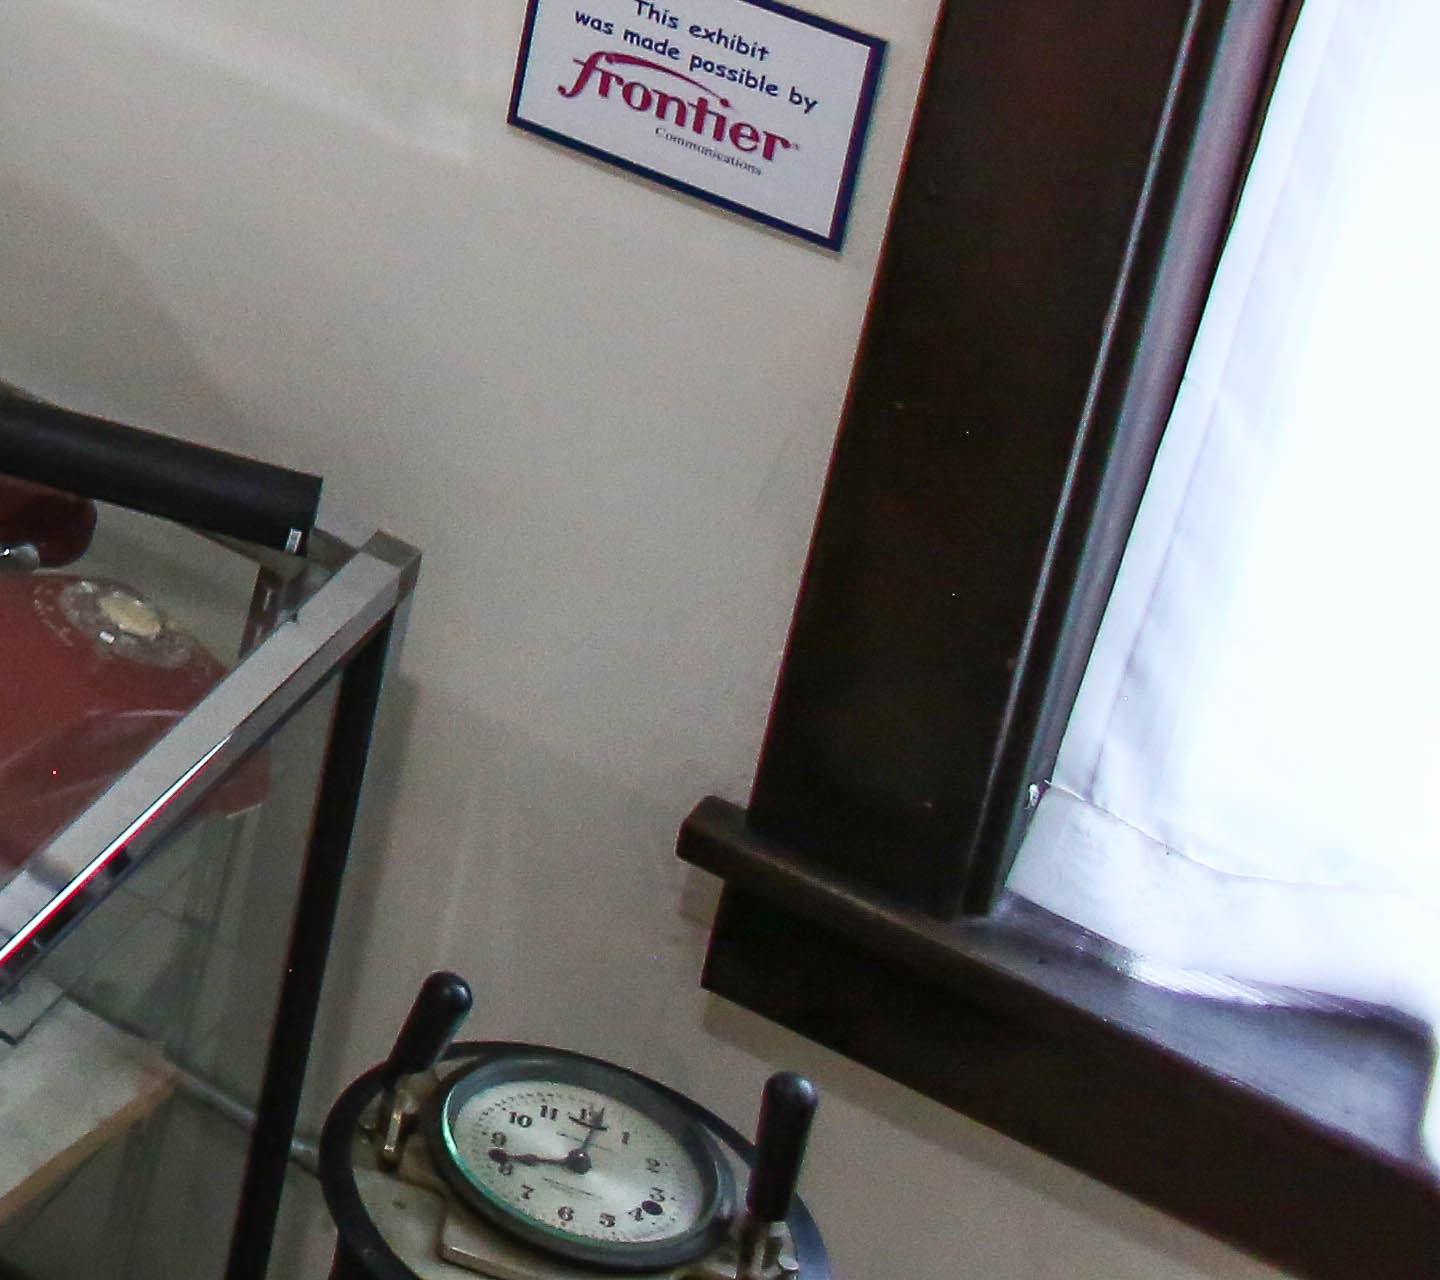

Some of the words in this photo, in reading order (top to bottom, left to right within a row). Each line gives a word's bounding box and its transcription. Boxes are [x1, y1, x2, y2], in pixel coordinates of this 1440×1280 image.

[576, 12, 613, 34] was
[624, 30, 679, 60] made
[690, 55, 777, 96] possible
[789, 87, 817, 113] by
[689, 26, 768, 61] exhibit
[557, 51, 790, 161] frontier
[656, 128, 761, 175] Communications
